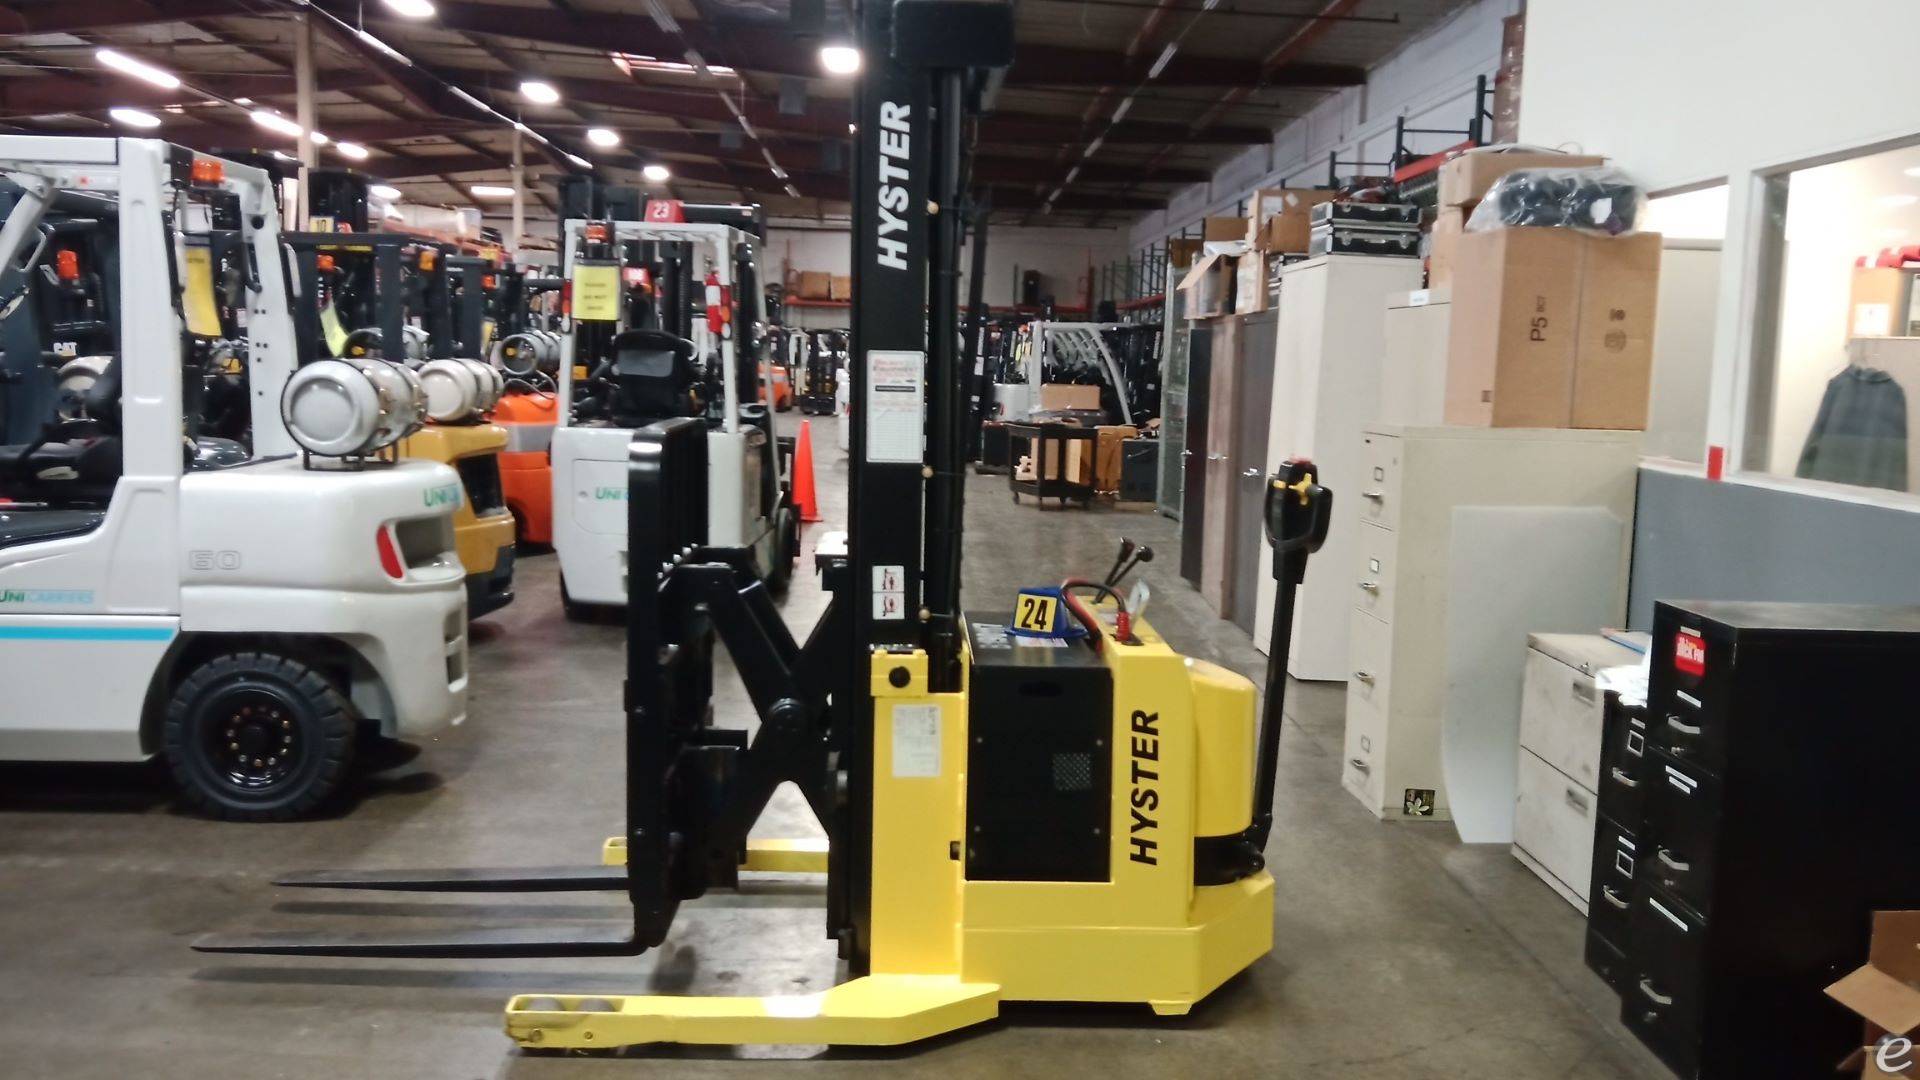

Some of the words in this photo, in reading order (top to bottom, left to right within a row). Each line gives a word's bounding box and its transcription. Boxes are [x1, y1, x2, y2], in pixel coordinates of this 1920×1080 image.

[877, 101, 911, 270] HYSTER
[652, 201, 670, 218] 23
[1530, 316, 1548, 342] P5
[53, 342, 78, 356] CAT
[188, 550, 242, 570] 60
[1020, 598, 1048, 630] 24
[1130, 709, 1159, 866] HYSTER
